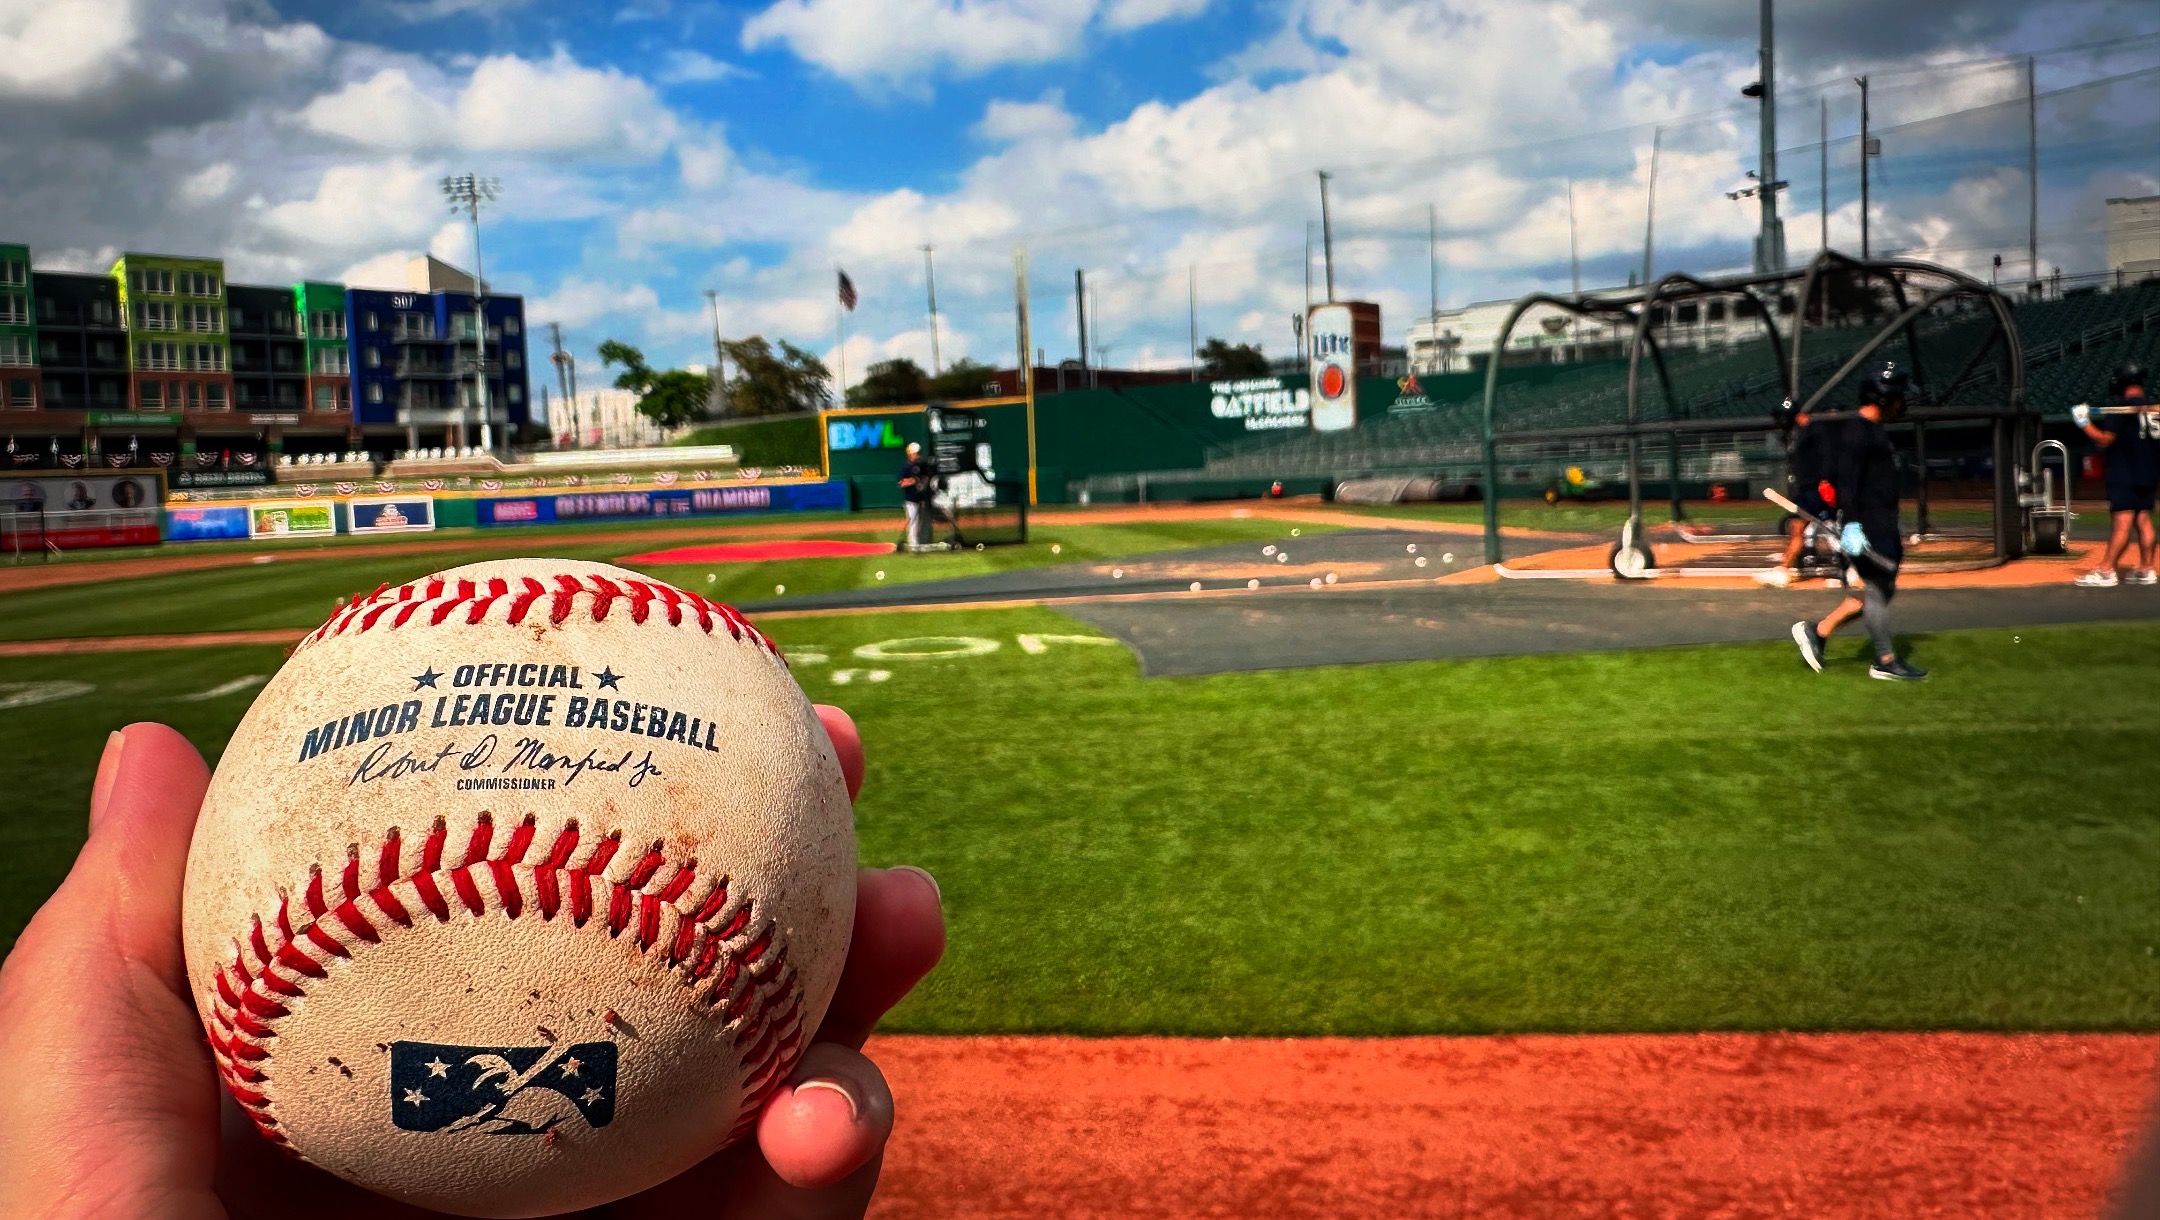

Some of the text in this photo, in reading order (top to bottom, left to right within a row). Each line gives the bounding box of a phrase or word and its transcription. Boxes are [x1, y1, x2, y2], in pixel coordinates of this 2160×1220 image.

[829, 420, 903, 449] BWL
[453, 664, 583, 689] OFFICIAL
[299, 694, 719, 762] MINOR LEAGUE BASEBALL
[457, 778, 556, 790] COMMISSIONER
